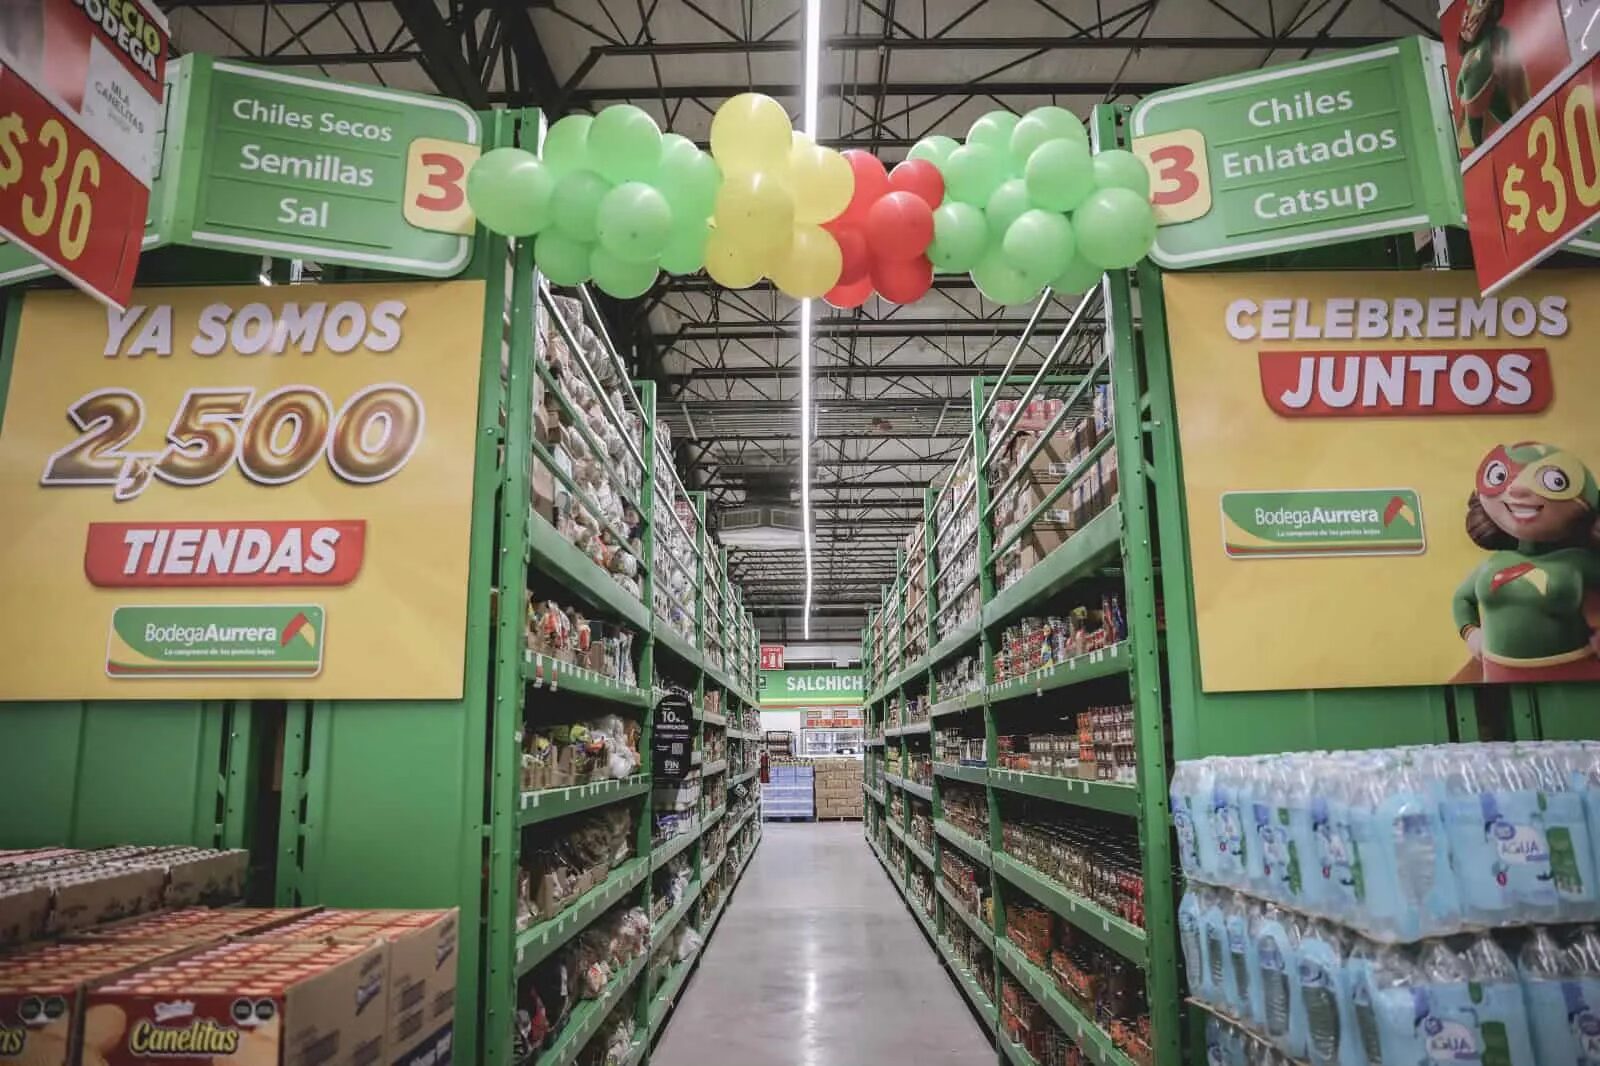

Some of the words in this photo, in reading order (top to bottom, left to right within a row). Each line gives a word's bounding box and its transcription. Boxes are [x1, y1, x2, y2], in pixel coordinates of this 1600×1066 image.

[73, 0, 157, 80] ODEGA
[232, 98, 313, 131] Chiles
[319, 107, 392, 142] Secos
[1248, 90, 1354, 128] Chiles
[239, 144, 374, 187] Semillas
[1150, 145, 1200, 205] 3
[1222, 129, 1398, 178] Enlatados
[1503, 85, 1600, 235] $30
[0, 111, 100, 261] $36
[416, 153, 465, 211] 3
[1254, 180, 1378, 221] Catsup
[277, 198, 328, 229] Sal
[103, 304, 172, 357] YA
[191, 300, 407, 355] SOMOS
[1225, 296, 1569, 341] CELEBREMOS
[1281, 353, 1532, 409] JUNTOS
[40, 382, 425, 502] 2,500
[122, 527, 341, 575] TIENDAS
[131, 1022, 239, 1053] Canelitas
